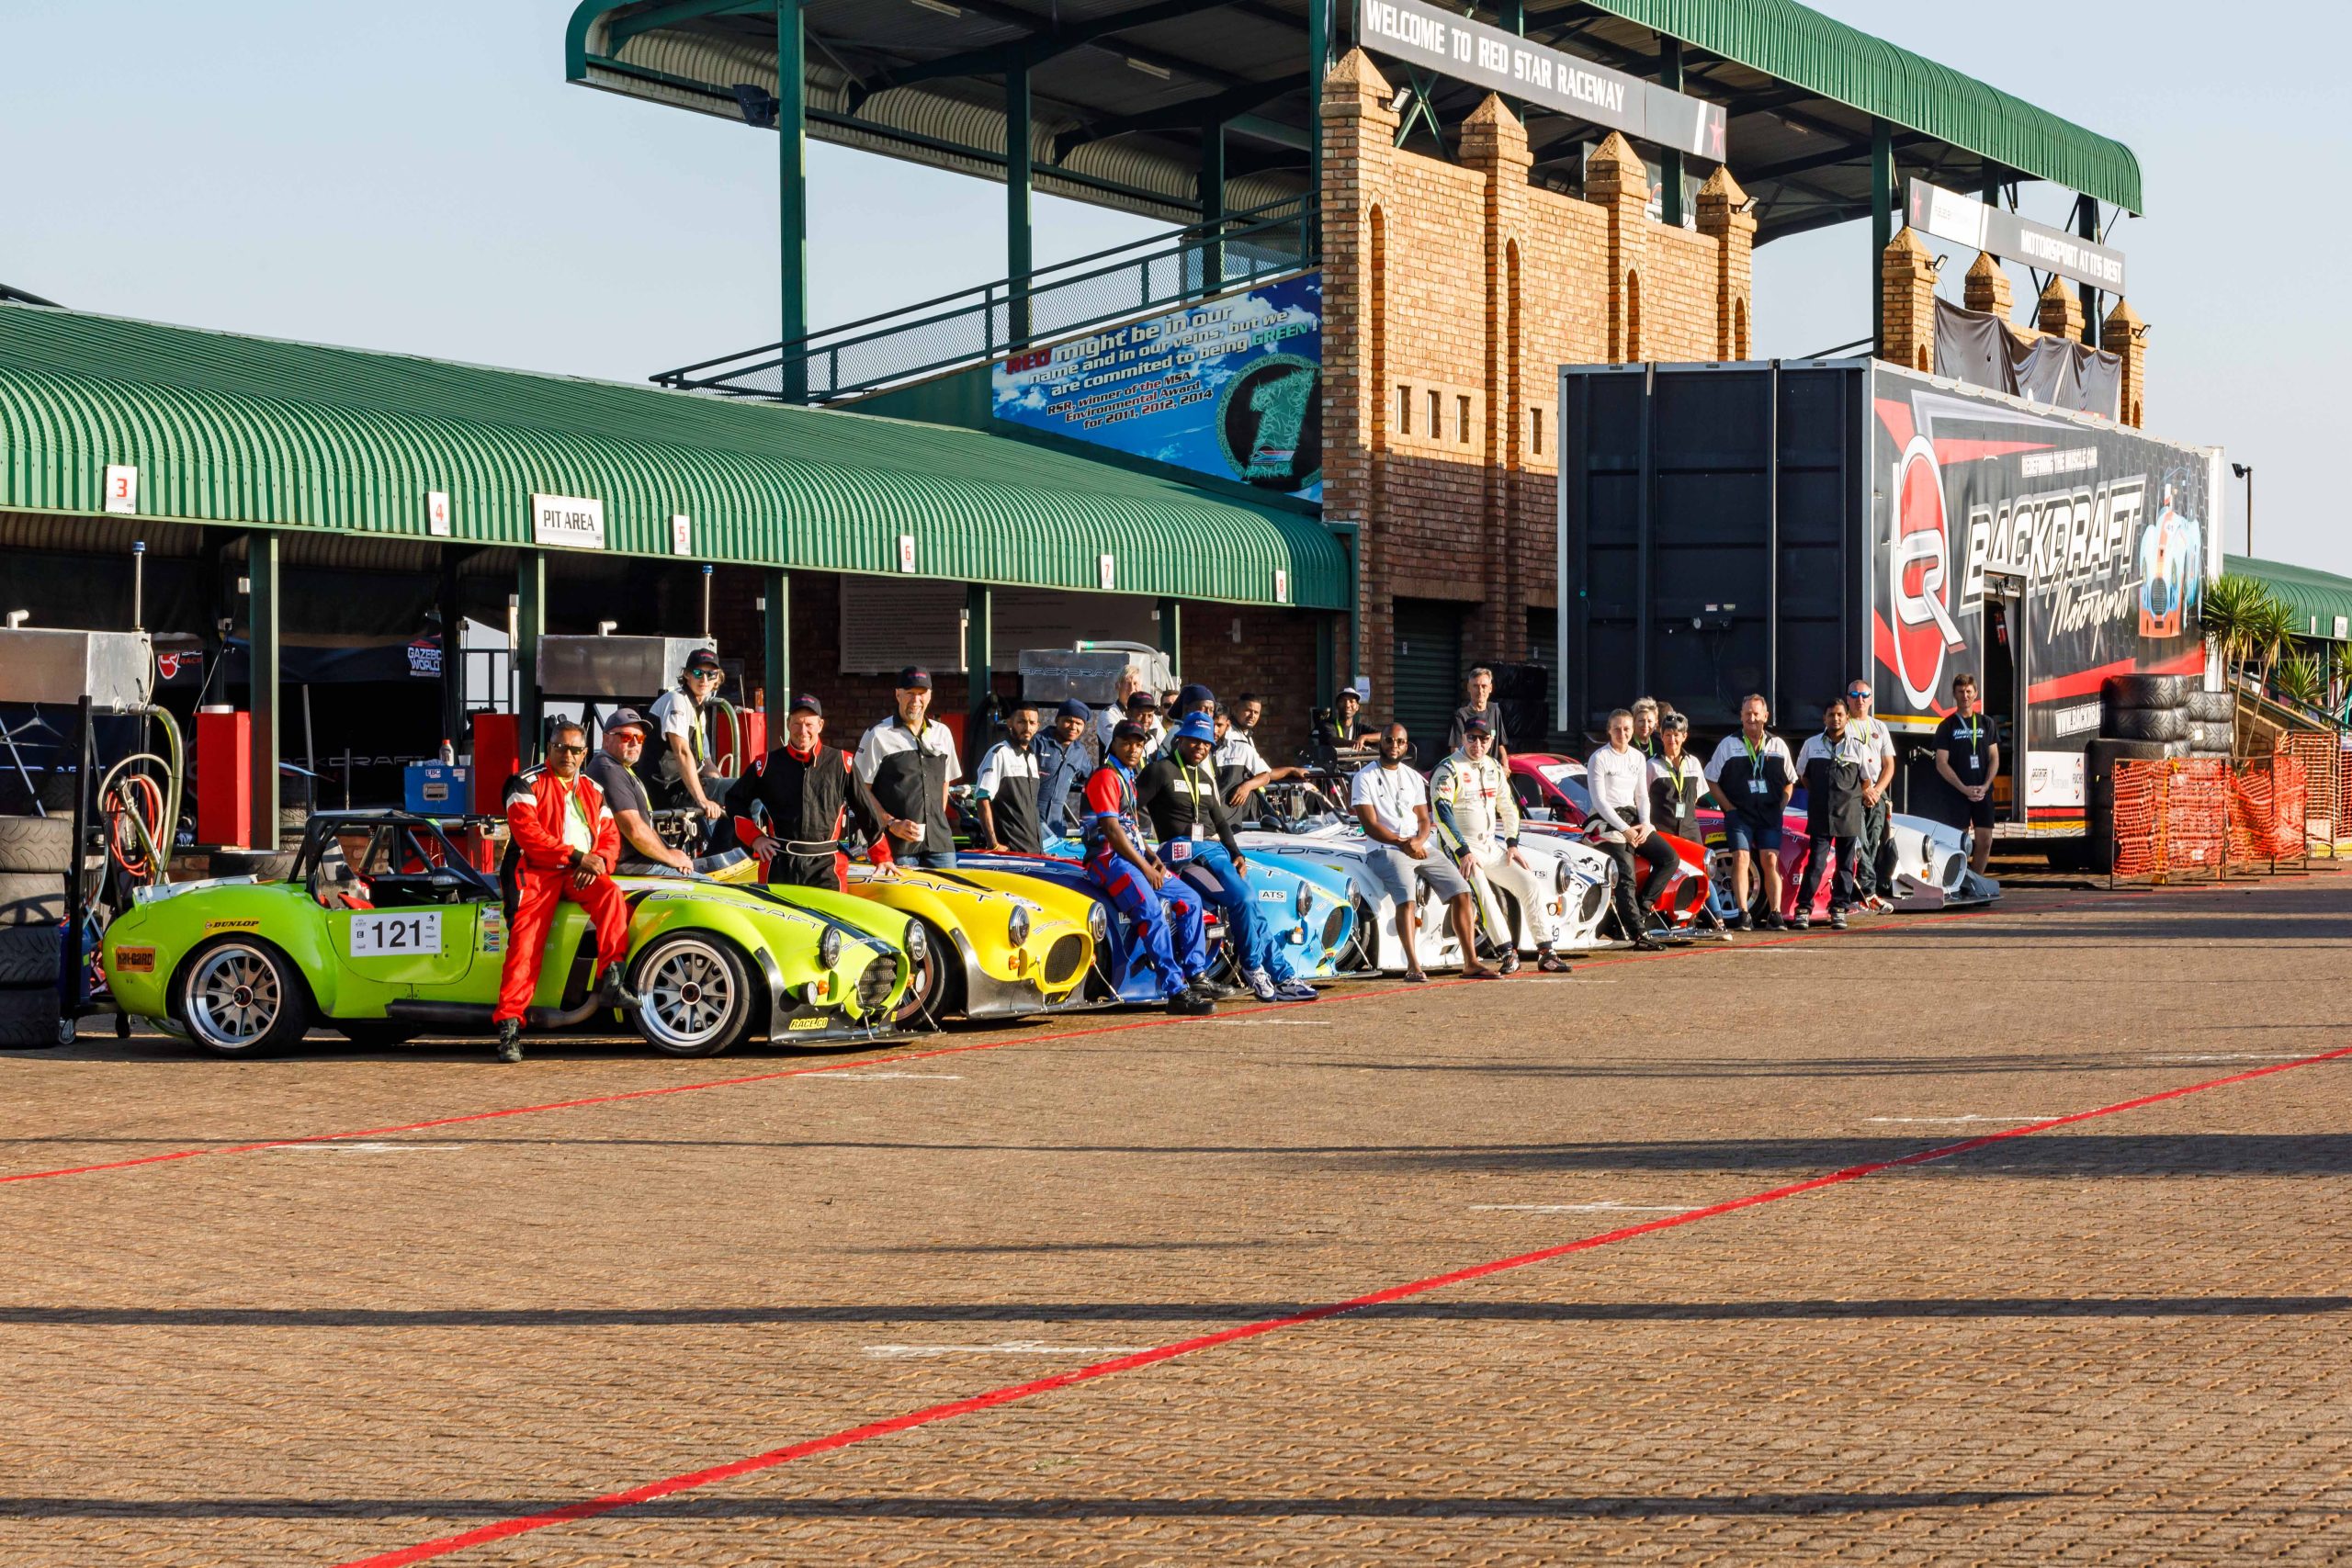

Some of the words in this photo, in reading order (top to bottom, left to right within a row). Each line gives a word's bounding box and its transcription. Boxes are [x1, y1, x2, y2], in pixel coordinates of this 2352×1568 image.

[1365, 0, 1445, 55] WELCOME
[1451, 28, 1472, 63] TO
[1478, 37, 1510, 73] RED
[1514, 49, 1552, 90] STAR
[1557, 62, 1625, 113] RACEWAY
[2020, 229, 2079, 269] MOTORSPORT
[2078, 249, 2090, 273] AT
[2089, 253, 2103, 278] ITS
[2103, 257, 2122, 285] BEST
[1006, 347, 1052, 375] RED
[1056, 331, 1127, 362] might
[1131, 325, 1160, 344] be
[1165, 317, 1187, 334] in
[1193, 307, 1232, 328] our
[1029, 363, 1079, 385] name
[1082, 351, 1115, 371] and
[1119, 349, 1136, 362] in
[1139, 341, 1169, 357] our
[1172, 330, 1224, 349] veins,
[1229, 317, 1260, 334] but
[1262, 311, 1289, 326] we
[1051, 380, 1080, 397] are
[1083, 355, 1172, 389] commited
[1176, 352, 1195, 366] to
[1199, 337, 1249, 359] being
[1251, 321, 1307, 346] GREEN
[1047, 400, 1076, 416] RSR,
[1078, 389, 1122, 408] winner
[1124, 383, 1139, 396] of
[1140, 379, 1161, 392] the
[1163, 370, 1192, 387] MSA
[1065, 391, 1158, 423] Environmental
[1159, 380, 1201, 400] Award
[1083, 417, 1103, 430] for
[1104, 408, 1139, 424] 2011,
[1141, 399, 1177, 415] 2012,
[1180, 389, 1213, 406] 2014
[116, 478, 128, 498] 3
[435, 502, 445, 522] 4
[543, 509, 561, 528] PIT
[564, 512, 595, 532] AREA
[678, 525, 685, 543] 5
[1960, 476, 2146, 614] BACKDRAFT
[904, 545, 911, 560] 6
[1104, 563, 1110, 580] 7
[1279, 579, 1284, 592] 8
[410, 659, 441, 671] WORLD
[1020, 667, 1119, 678] BACKDRAF
[1261, 890, 1285, 899] ATS
[649, 893, 821, 930] BACKDRAFT
[212, 920, 260, 929] DUNLOP
[371, 919, 421, 949] 121
[789, 1017, 829, 1031] RACE.CO
